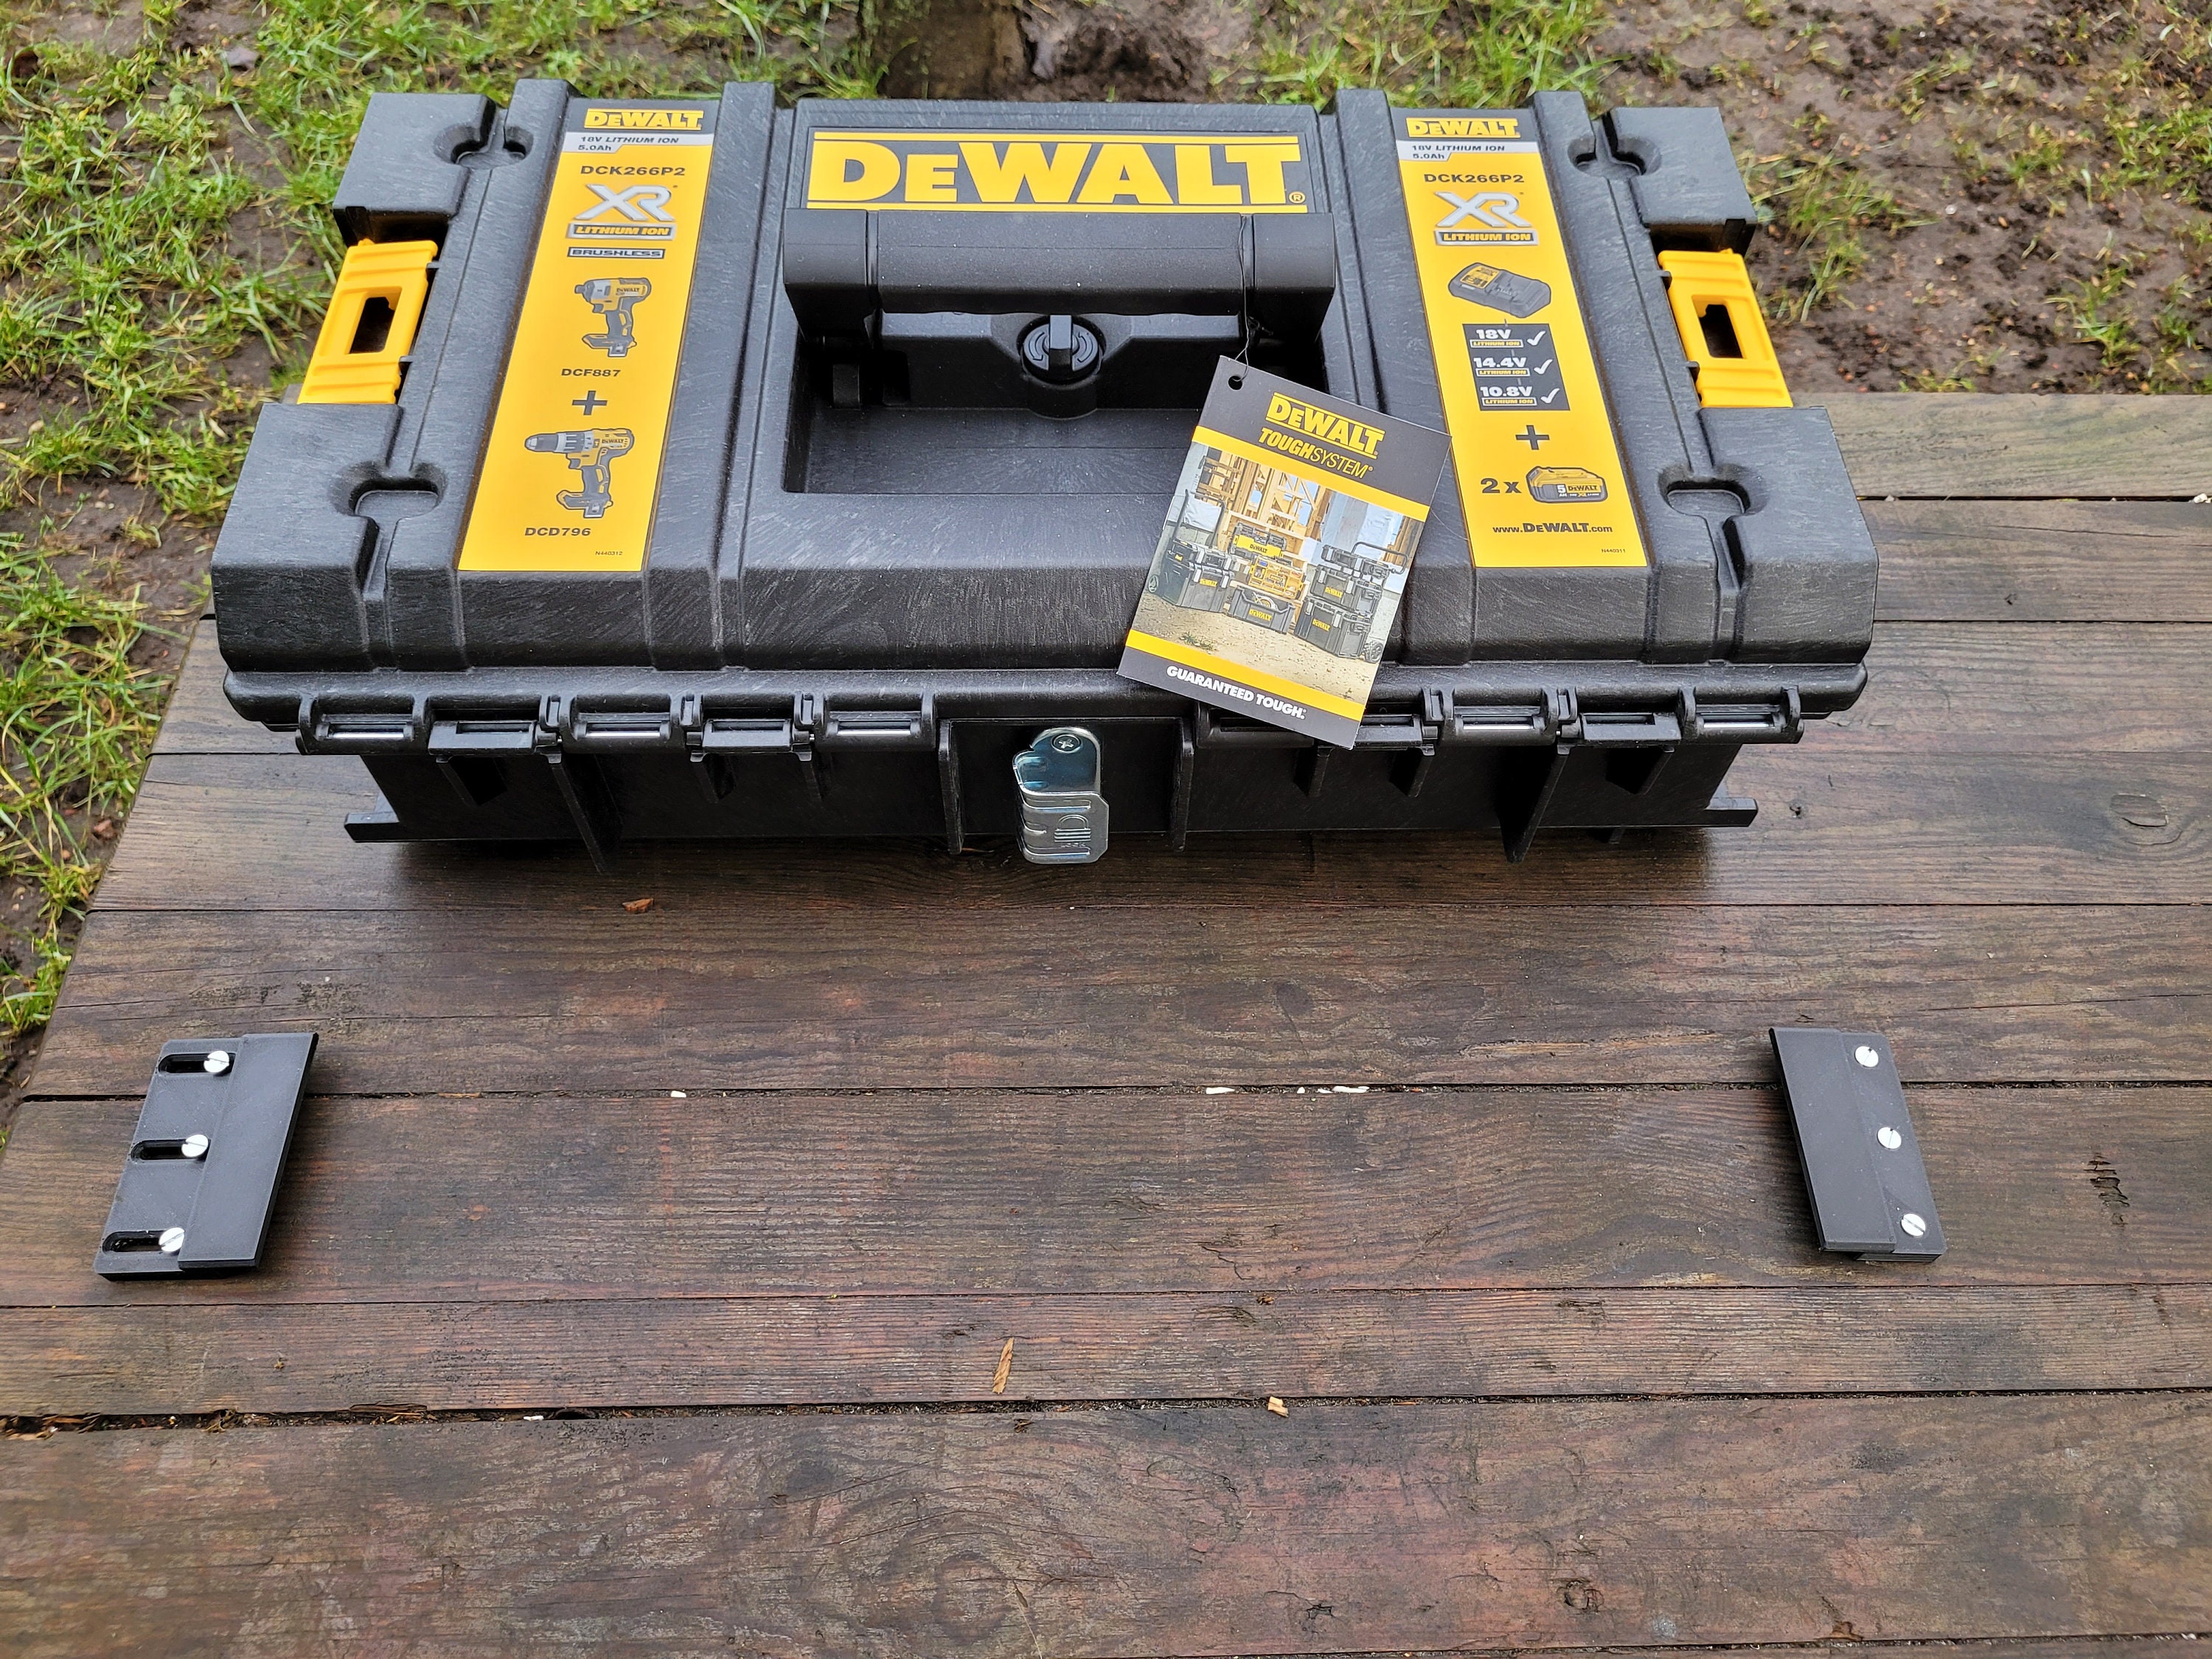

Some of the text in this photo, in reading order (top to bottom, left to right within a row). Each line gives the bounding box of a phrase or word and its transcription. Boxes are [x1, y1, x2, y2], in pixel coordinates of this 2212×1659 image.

[585, 111, 703, 128] DEWALT
[1406, 120, 1519, 136] DEWALT
[580, 165, 686, 176] DCK266P2
[1424, 173, 1525, 184] DCK266P2
[575, 226, 670, 236] LITHIUM ION
[1442, 233, 1531, 241] LITHIUM ION
[572, 248, 661, 257] BRUSHLESS
[1476, 329, 1511, 339] 18V
[1473, 357, 1526, 368] 14.4V
[561, 368, 621, 377] DCF887
[1480, 386, 1532, 397] 10.8V
[1481, 478, 1522, 494] 2 x
[1557, 484, 1566, 493] 5
[524, 527, 591, 536] DCD796
[1166, 665, 1255, 702] GUARANTEED
